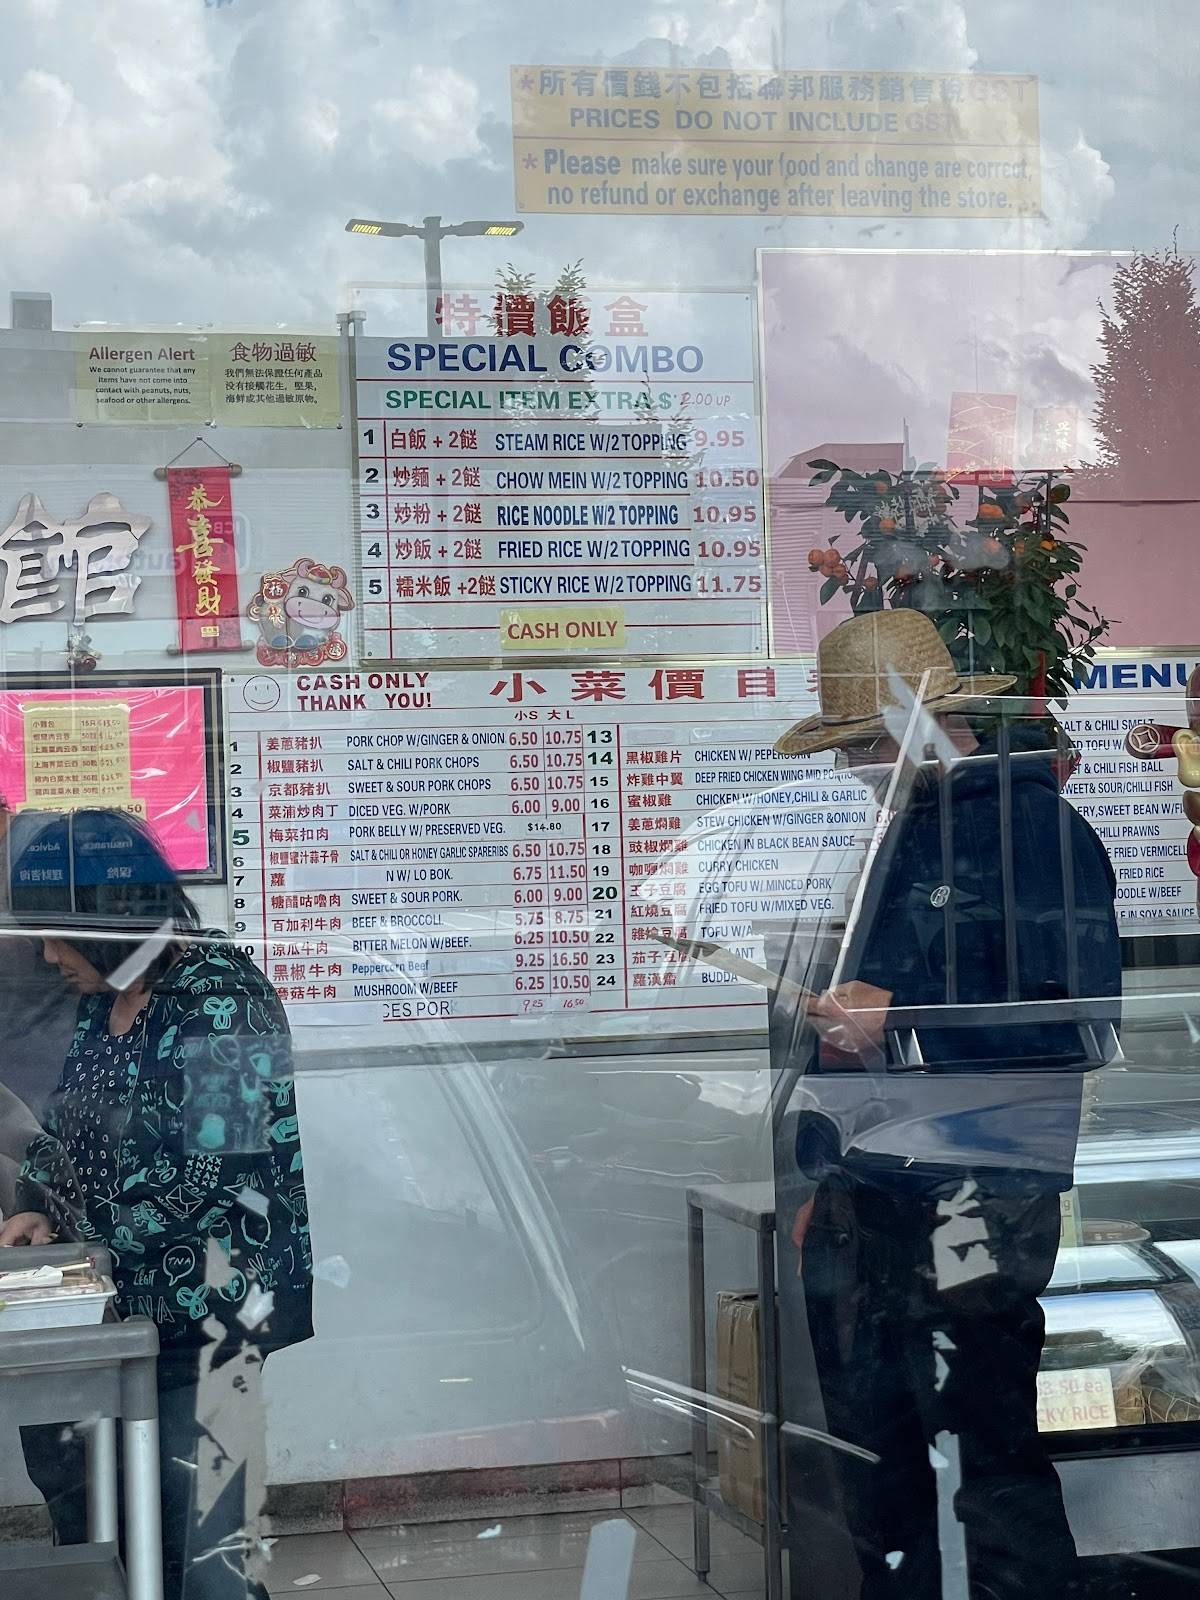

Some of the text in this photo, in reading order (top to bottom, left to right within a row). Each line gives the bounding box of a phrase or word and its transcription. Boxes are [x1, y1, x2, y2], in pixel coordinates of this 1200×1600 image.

[570, 108, 898, 132] PRICES DO NOT INCLUDE
[544, 149, 621, 175] Please
[631, 152, 682, 176] make
[687, 158, 726, 176] sure
[732, 158, 773, 181] your
[779, 152, 820, 177] food
[826, 154, 859, 177] and
[865, 154, 928, 182] change
[935, 161, 961, 178] are
[548, 180, 1012, 213] no refund or exchange after leaving the store.
[435, 294, 648, 337] 特價飯盒
[89, 346, 196, 363] Allergen Alert
[231, 342, 317, 363] 食物過敏
[387, 343, 704, 374] SPECIAL COMBO
[89, 366, 196, 377] We cannot guarantee that any
[119, 376, 137, 384] have
[95, 386, 121, 394] contact
[123, 386, 140, 394] with
[385, 389, 651, 411] SPECIAL ITEM EXTRA
[157, 396, 191, 406] allergens.
[391, 429, 745, 451] 白飯 STEAM RICE 9.95
[496, 472, 544, 489] CHOW
[549, 472, 587, 489] MEIN
[696, 469, 759, 488] 10.50
[395, 502, 757, 525] 炒粉 RICE NOODLE W/2 TOPPING 10.95
[176, 483, 224, 616] 恭喜發財
[395, 539, 761, 560] 炒飯 FRIED RICE 10.95
[500, 576, 554, 595] STICKY
[559, 576, 590, 594] RICE
[698, 575, 762, 593] 11.75
[507, 621, 618, 640] CASH ONLY
[297, 672, 429, 691] CASH ONLY
[297, 692, 432, 711] THANK YOU!
[346, 736, 374, 747] PORK
[376, 736, 404, 747] CHOP
[406, 734, 459, 746] W/GINGER
[472, 732, 505, 745] ONION
[509, 731, 538, 746] 6.50
[545, 731, 581, 745] 10.75
[347, 750, 736, 771] SALT CHILI PORK CHOPS 6.50 10.75 黑椒雞片 CHICKEN
[268, 769, 803, 797] 京都豬扒 SWEET SOUR PORK CHOPS 6.50 10.75 炸雞中翼 DEEP FRIED CHICKEN WING
[1153, 780, 1173, 792] FISH
[349, 793, 740, 817] DICED W/PORK 6.00 9.00 蜜椒雞 CHICKEN
[269, 823, 480, 843] 梅菜扣肉 PORK BELLY PRESERVED
[1122, 825, 1160, 837] PRAWNS
[350, 842, 585, 862] SALT HONEY GARLIC 6.50 10.75
[513, 859, 779, 880] 6.75 11.50 CURRY CHICKEN
[1119, 866, 1164, 879] FRIED RICE
[351, 881, 748, 905] SWEET 6.00 9.00 TOFU
[1148, 886, 1182, 899] W/BEEF
[271, 916, 377, 931] 百加利牛肉 BEEF
[352, 939, 388, 951] BITTER
[273, 960, 429, 981] 黑椒牛肉 Beef
[354, 982, 458, 997] MUSHROOM W/BEEF
[168, 1256, 191, 1266] TNA
